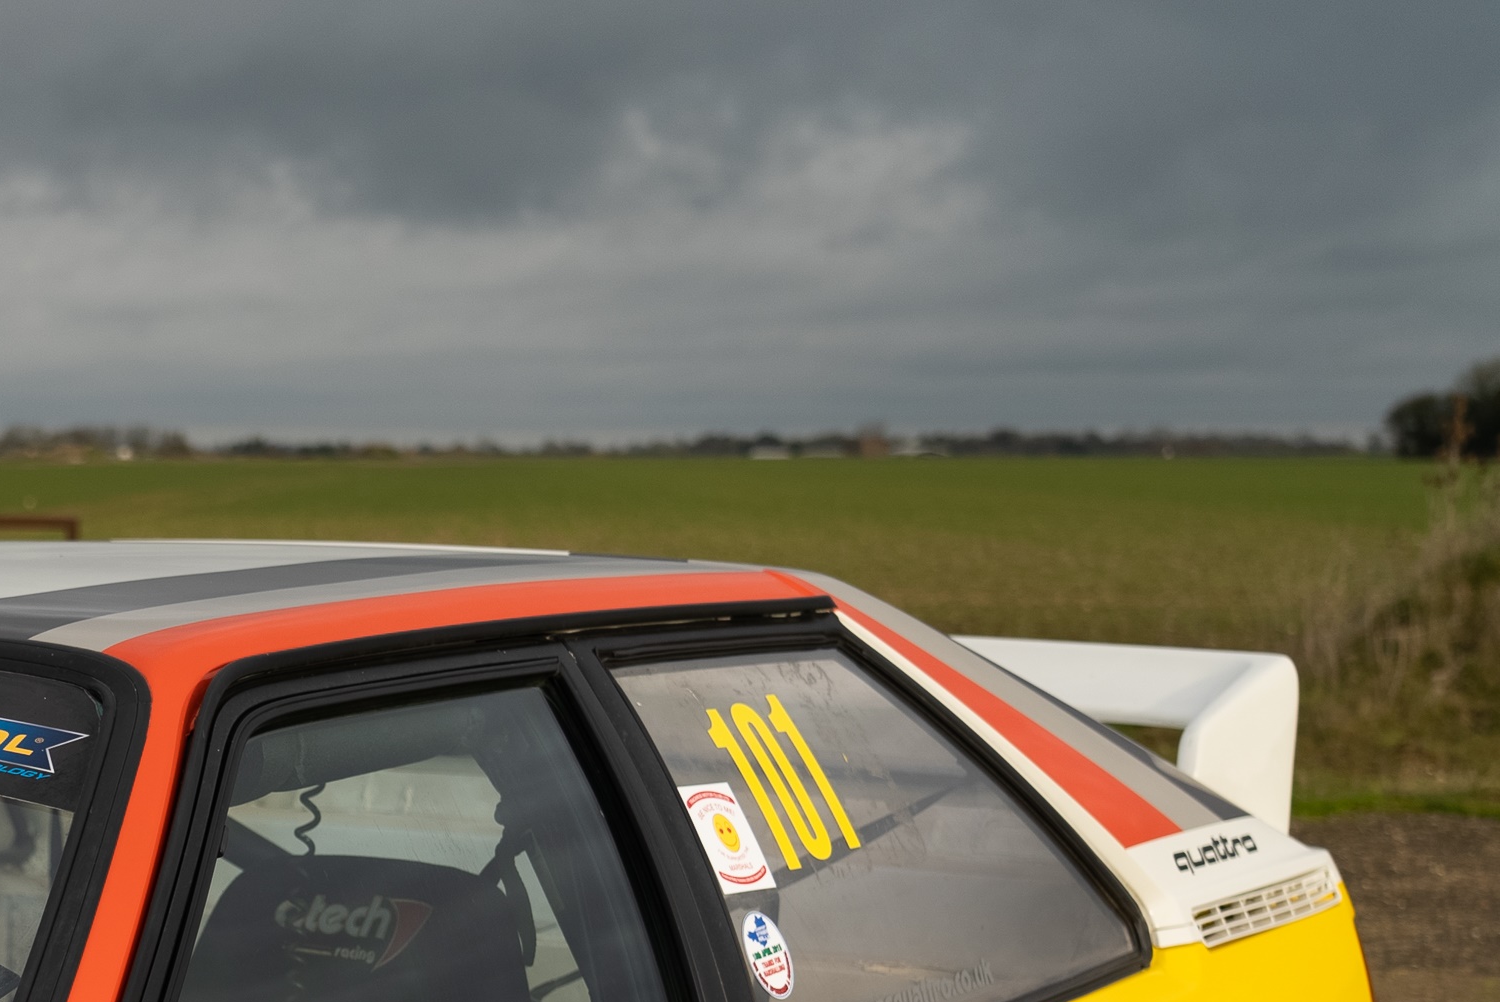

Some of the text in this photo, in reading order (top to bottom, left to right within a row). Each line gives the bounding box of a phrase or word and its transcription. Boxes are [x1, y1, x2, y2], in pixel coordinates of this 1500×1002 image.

[706, 694, 861, 870] 101
[1173, 834, 1258, 875] quattro
[333, 945, 376, 964] racing
